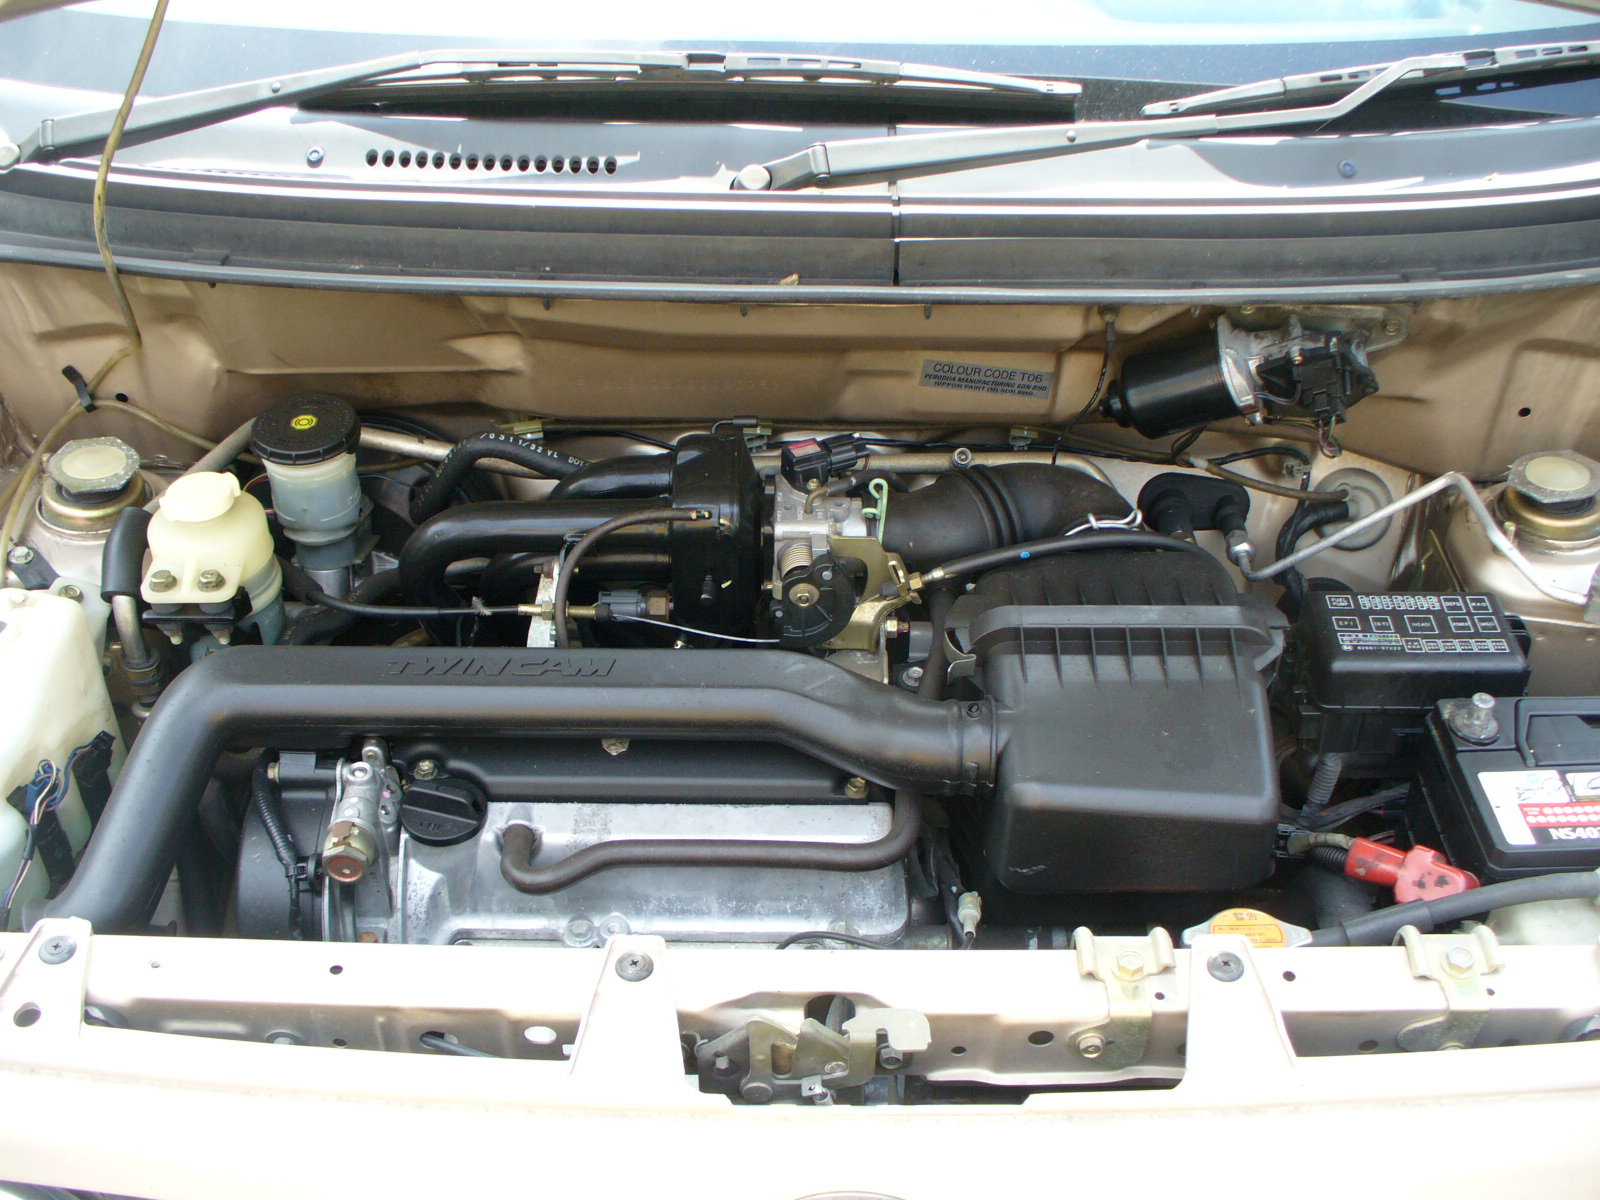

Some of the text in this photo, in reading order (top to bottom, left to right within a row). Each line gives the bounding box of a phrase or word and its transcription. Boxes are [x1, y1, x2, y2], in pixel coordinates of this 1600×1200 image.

[924, 373, 956, 382] PERODUA
[958, 377, 1015, 388] MANUFACTURING
[933, 362, 1043, 383] COLOUR CODE T06
[934, 381, 962, 389] NIPPON
[387, 658, 617, 677] TWIN CAM
